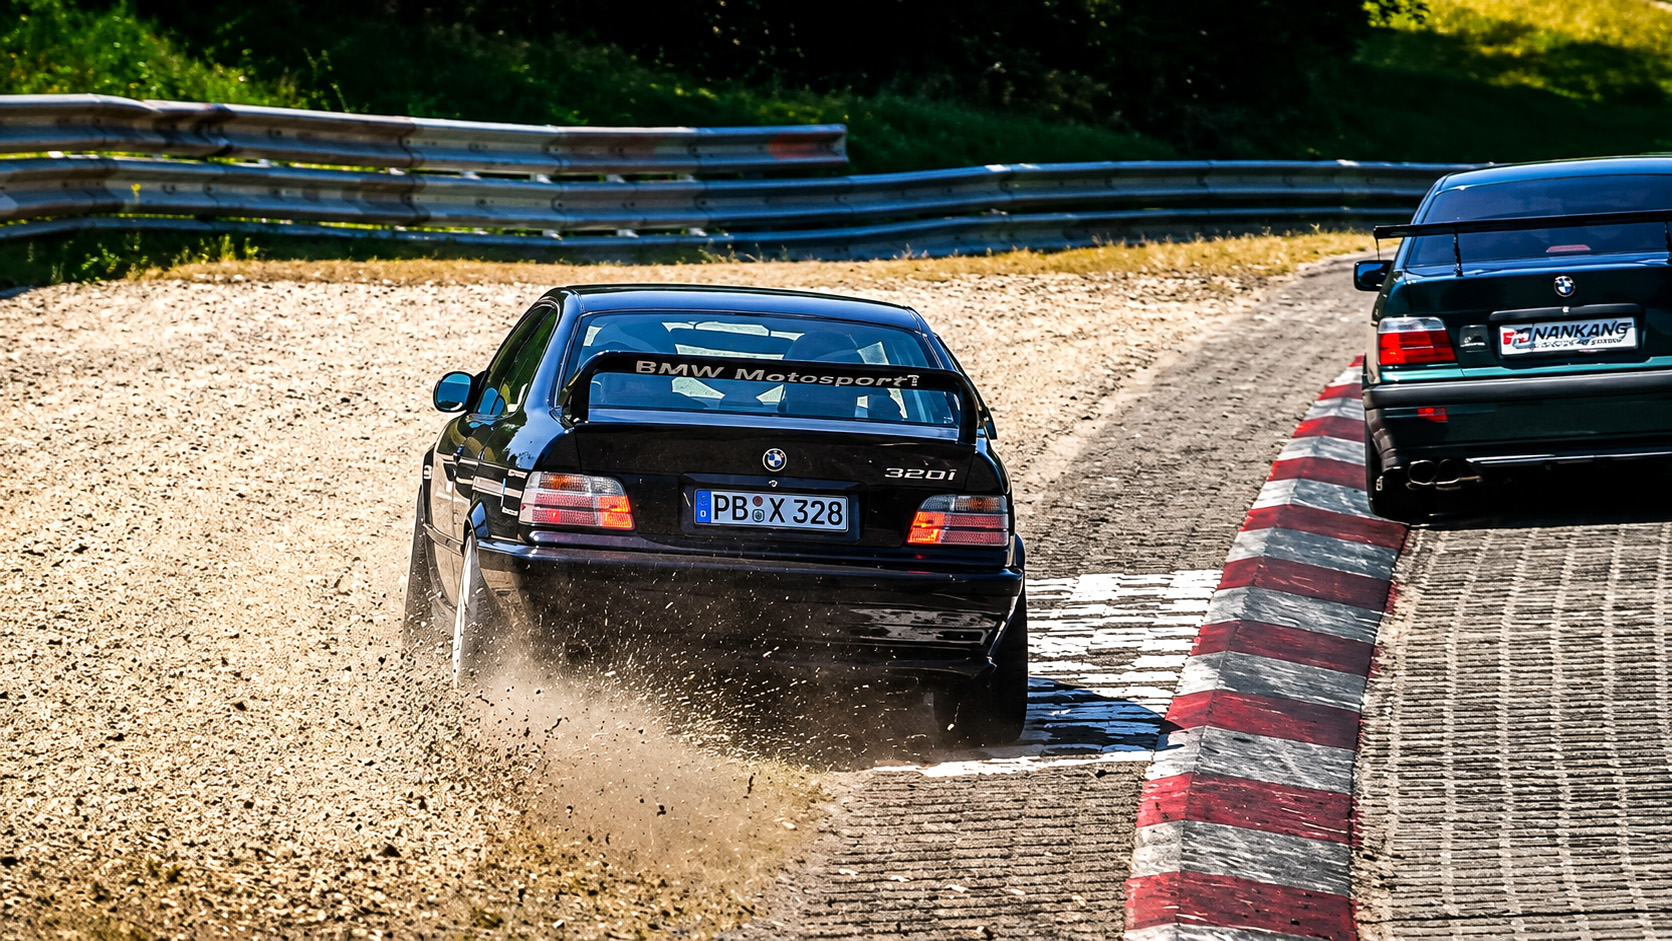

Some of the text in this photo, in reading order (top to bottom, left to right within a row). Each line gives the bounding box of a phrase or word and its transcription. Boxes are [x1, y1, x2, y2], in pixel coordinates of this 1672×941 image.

[1532, 321, 1633, 340] NANKANG
[635, 360, 724, 378] BMW
[884, 467, 958, 481] 320i
[713, 494, 844, 526] PB X 328
